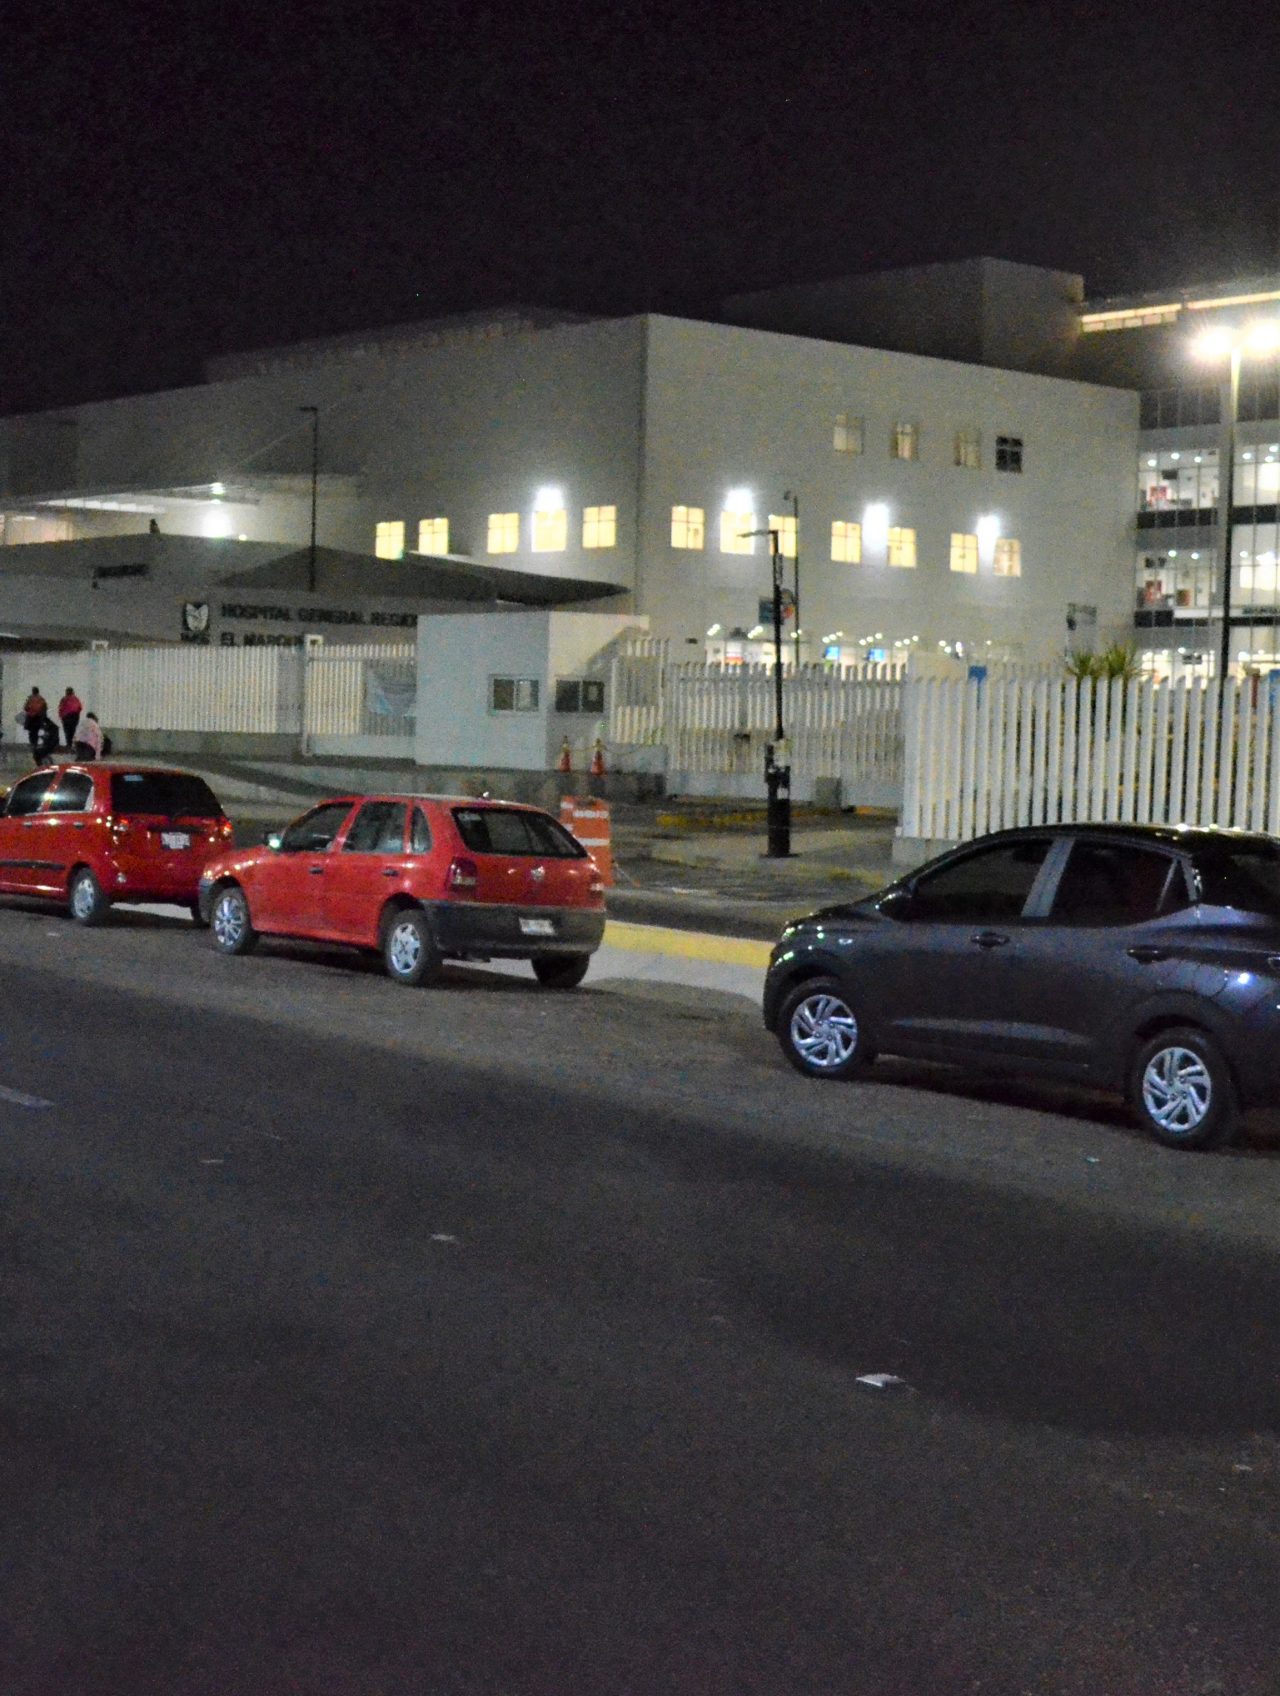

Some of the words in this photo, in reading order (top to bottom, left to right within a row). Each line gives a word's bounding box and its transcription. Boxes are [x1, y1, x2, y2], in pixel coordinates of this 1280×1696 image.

[221, 603, 291, 621] HOSPITAL
[297, 607, 365, 626] GENERAL
[221, 632, 236, 647] EL
